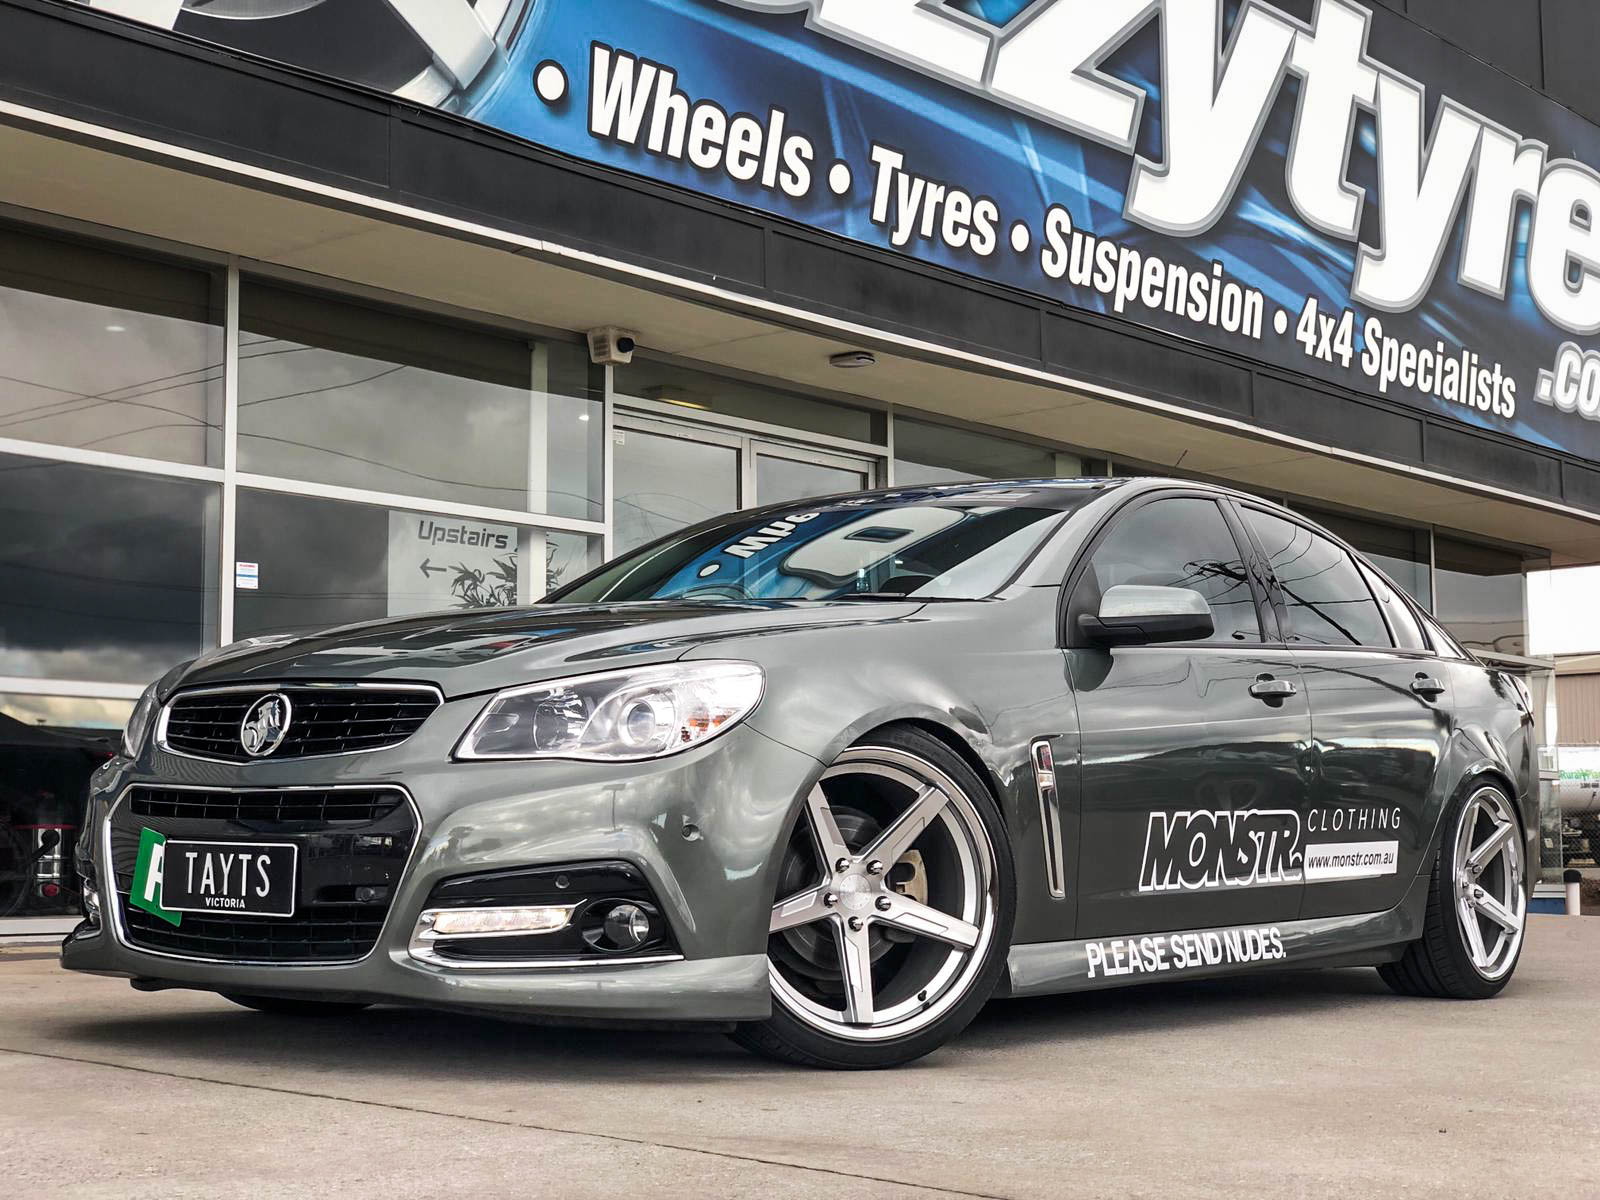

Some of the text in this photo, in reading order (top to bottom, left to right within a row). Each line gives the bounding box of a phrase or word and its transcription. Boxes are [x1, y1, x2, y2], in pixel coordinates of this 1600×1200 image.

[591, 45, 1517, 419] Wheels Tyres Suspension 4x4 Specialists
[418, 520, 509, 550] Upstairs
[1307, 807, 1401, 833] CLOTHING
[185, 851, 272, 898] TAYTS
[1307, 851, 1395, 869] www.monstr.com.au
[205, 897, 246, 909] VICTORIA
[1085, 926, 1287, 979] PLEASE SEND NUDES.
